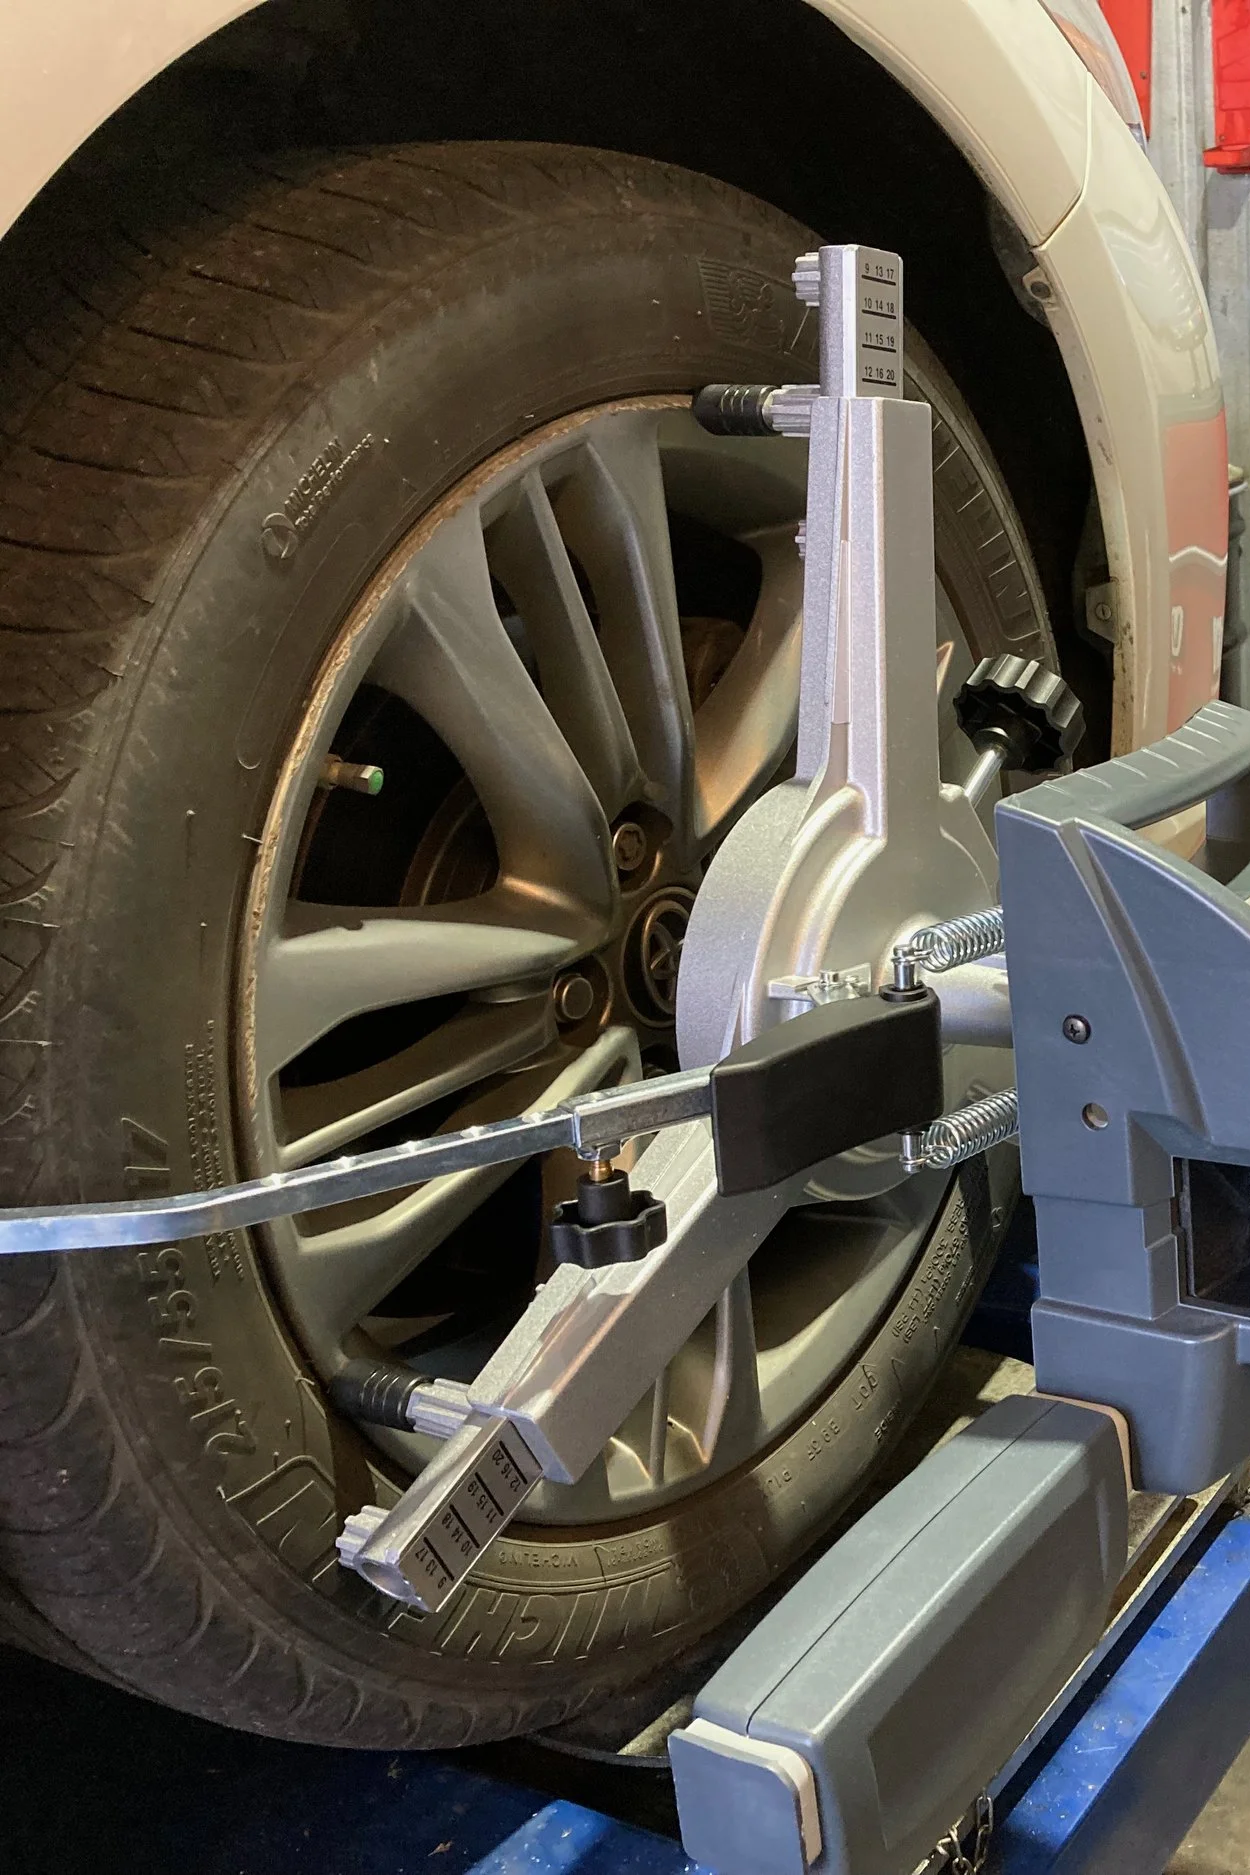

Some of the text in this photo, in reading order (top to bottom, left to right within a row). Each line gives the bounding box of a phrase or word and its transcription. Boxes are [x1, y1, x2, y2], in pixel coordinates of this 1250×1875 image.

[864, 263, 895, 279] 9 13 17
[864, 297, 895, 313] 10 14 18
[864, 332, 895, 347] 11 15 19
[864, 366, 895, 381] 12 16 20
[284, 435, 342, 515] MICHELIN
[492, 1450, 521, 1492] 12 16 20
[467, 1480, 497, 1523] 11 15 19
[441, 1513, 473, 1556] 10 14 18
[415, 1547, 447, 1589] 9 13 17
